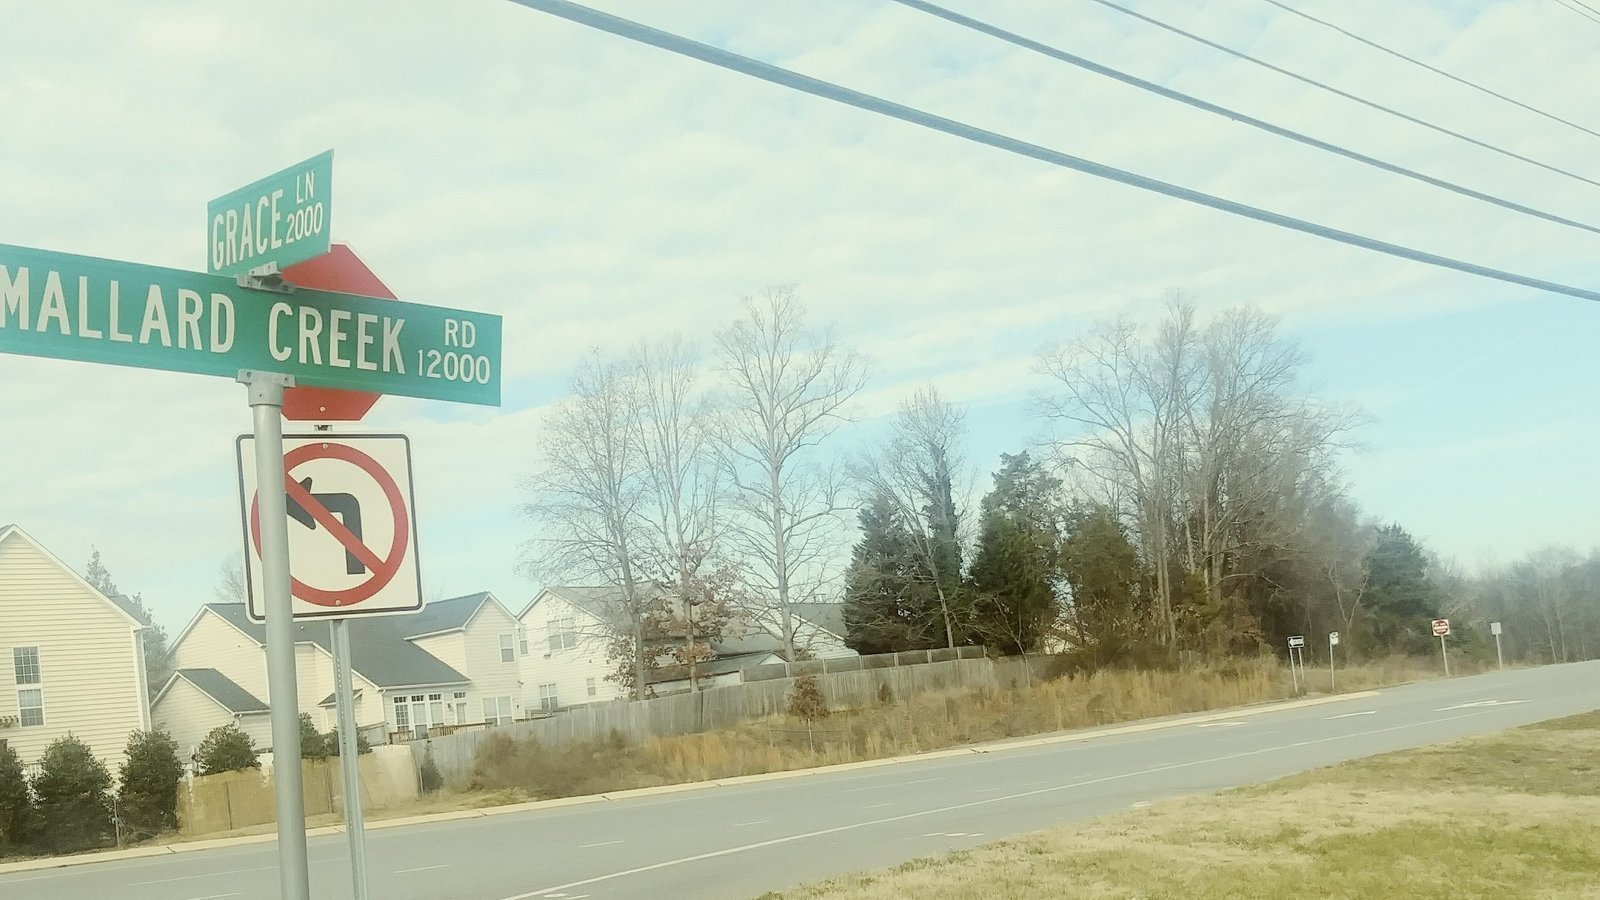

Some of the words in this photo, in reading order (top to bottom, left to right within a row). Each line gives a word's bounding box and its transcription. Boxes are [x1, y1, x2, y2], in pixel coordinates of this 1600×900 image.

[296, 170, 315, 204] LN
[212, 188, 284, 271] GRACE
[285, 202, 323, 244] 2000
[0, 264, 236, 354] MALLARD
[268, 301, 406, 375] CREEK
[444, 318, 476, 349] RD
[417, 349, 491, 385] 12000
